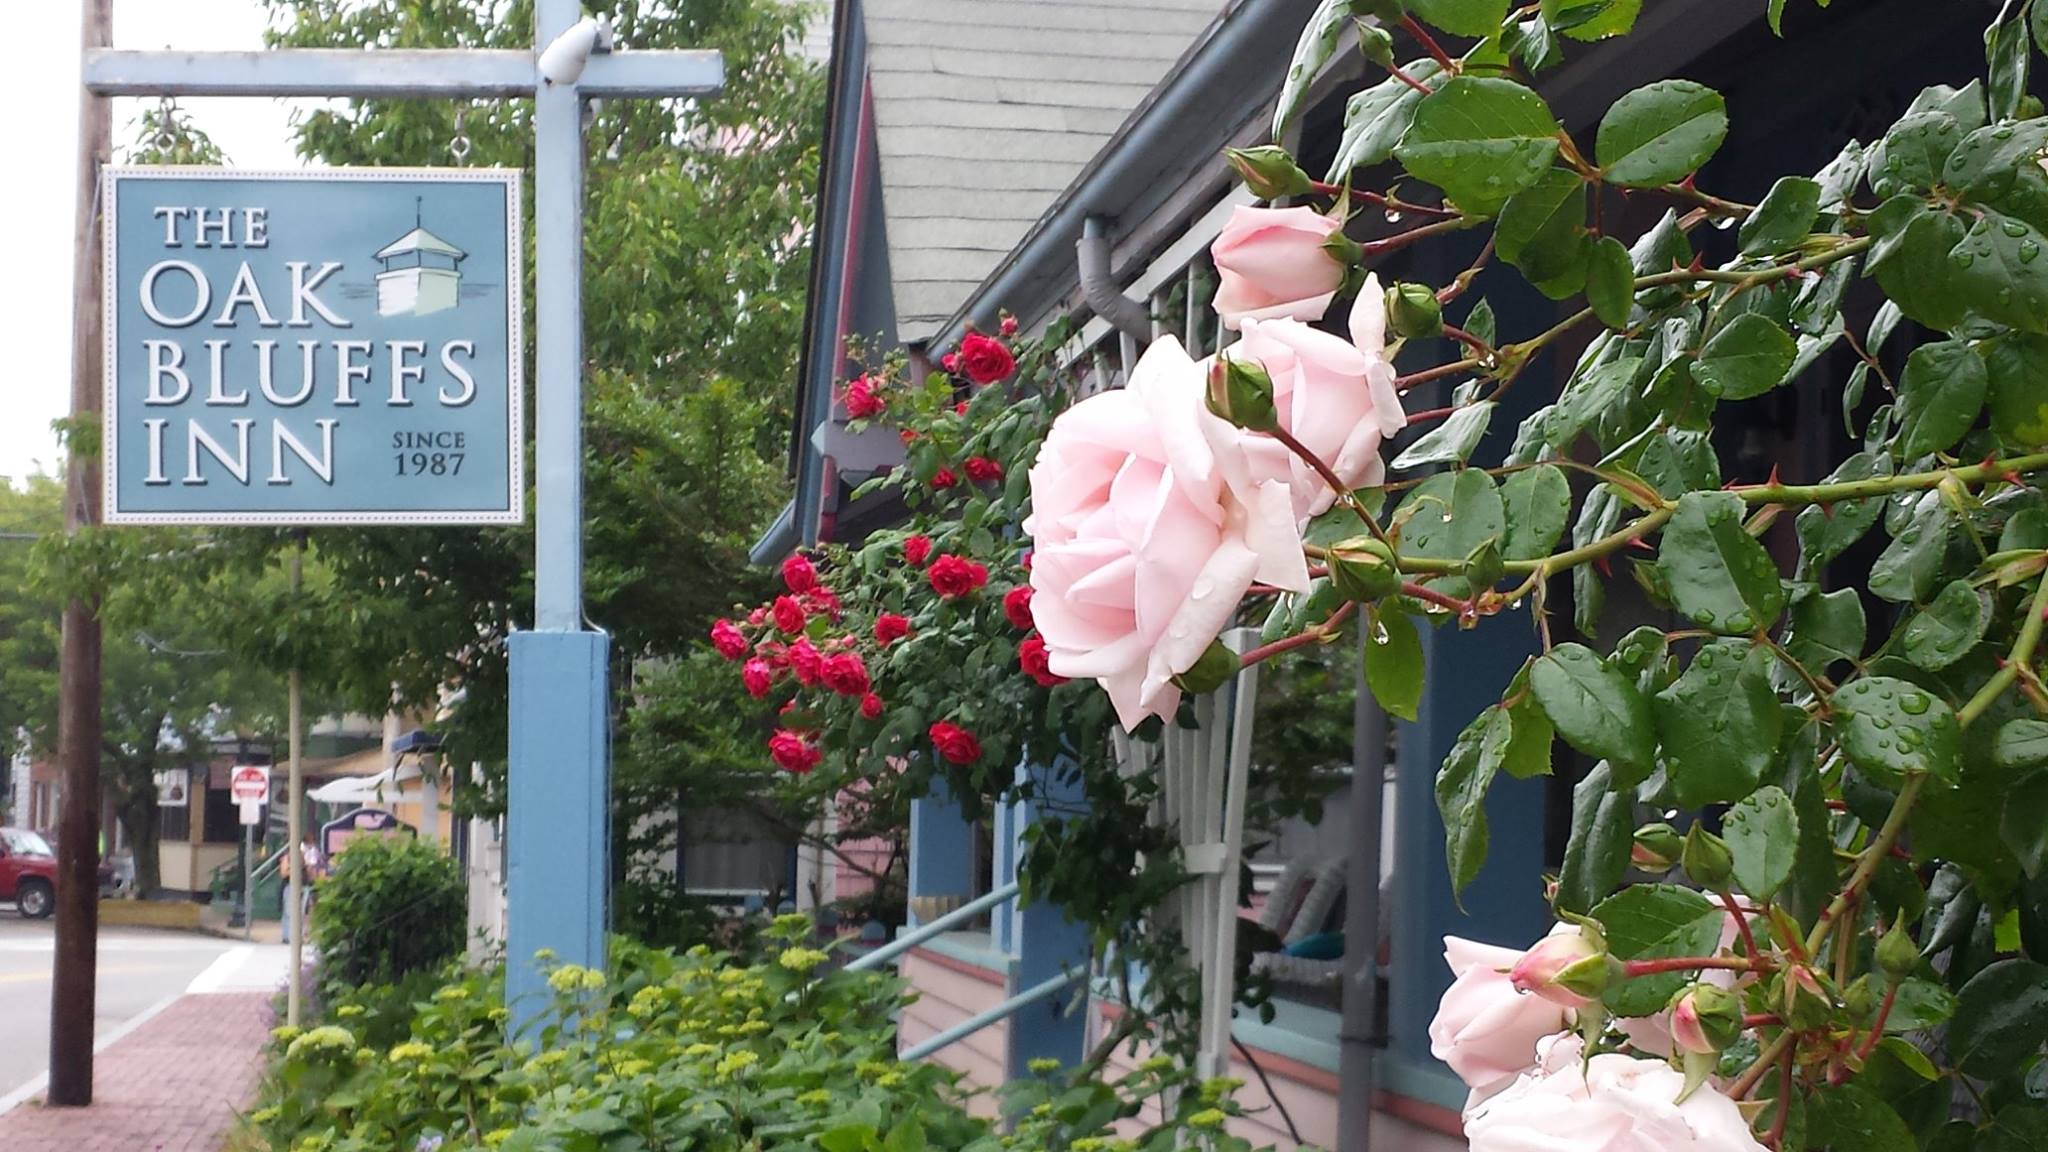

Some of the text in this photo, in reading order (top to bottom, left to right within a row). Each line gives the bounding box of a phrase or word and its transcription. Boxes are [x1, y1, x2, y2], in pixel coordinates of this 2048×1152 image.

[154, 206, 269, 247] THE
[140, 259, 353, 328] OAK
[143, 339, 477, 407] BLUFFS
[143, 418, 339, 486] INN
[392, 431, 465, 449] SINCE
[394, 452, 465, 477] 1987
